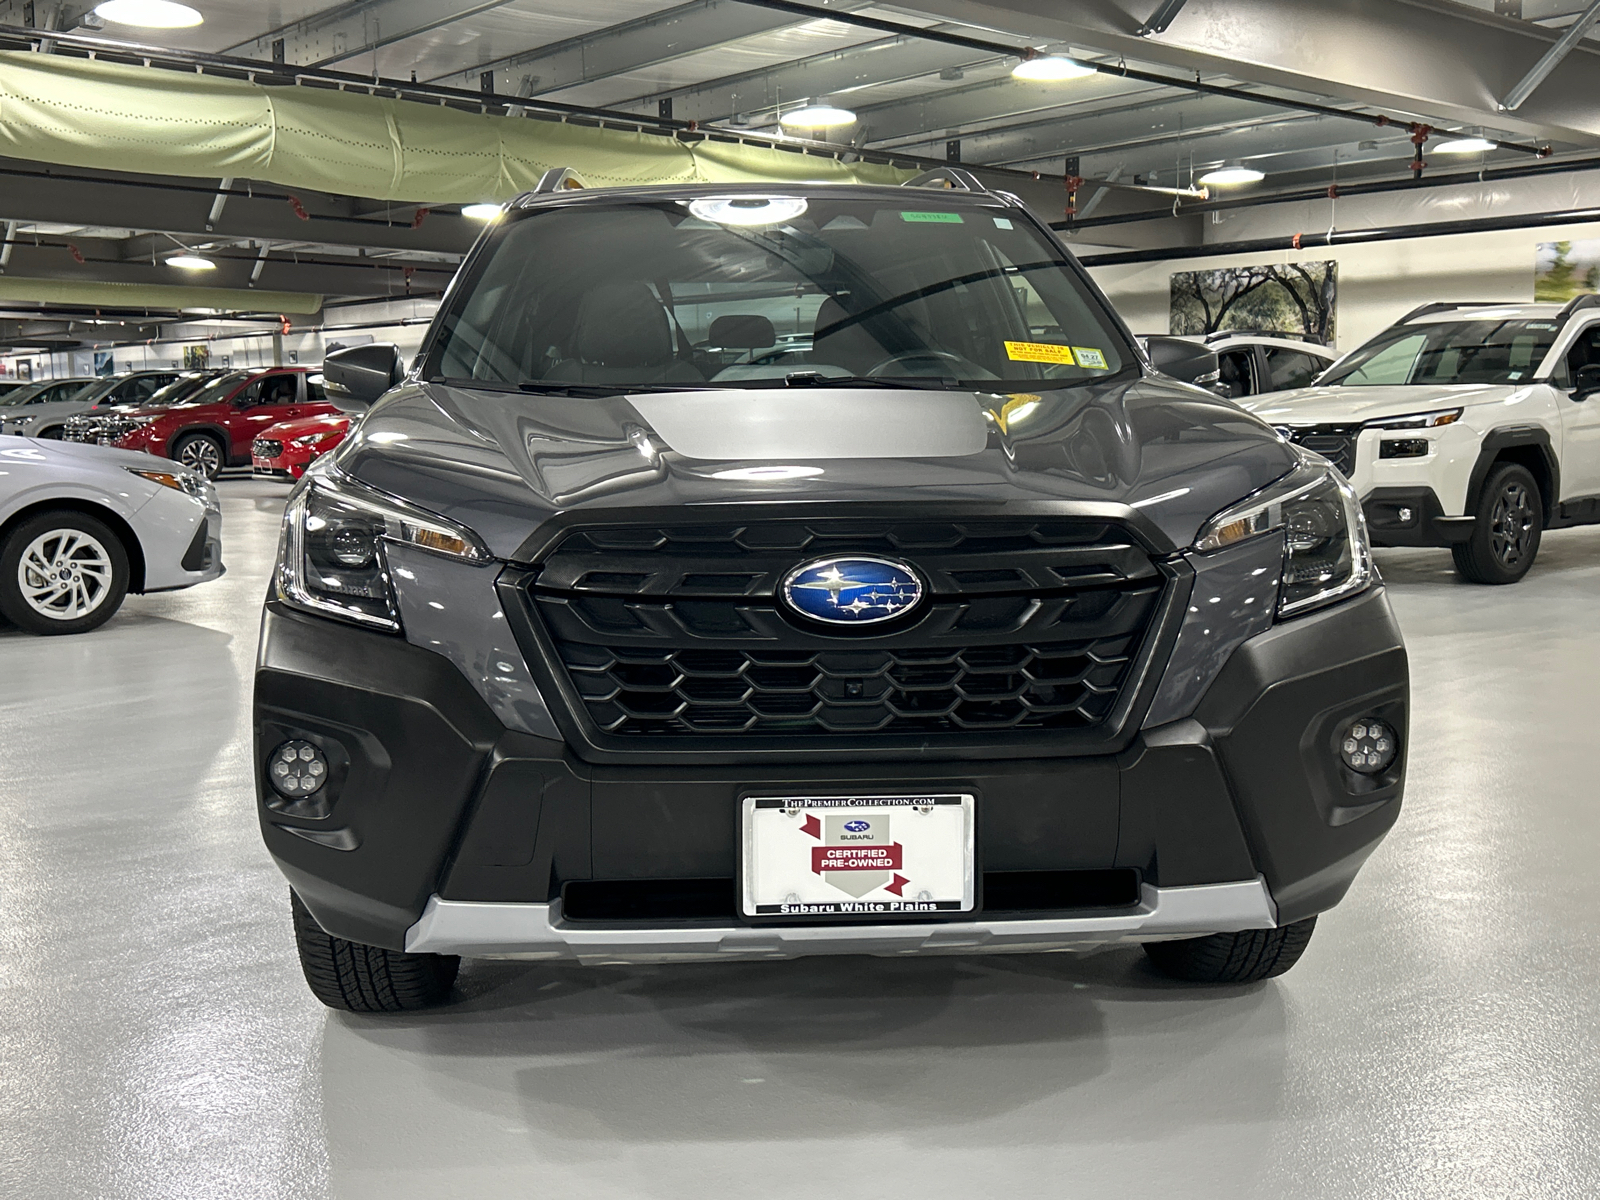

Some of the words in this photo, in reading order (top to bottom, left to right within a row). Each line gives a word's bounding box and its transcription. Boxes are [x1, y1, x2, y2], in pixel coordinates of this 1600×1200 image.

[827, 849, 887, 858] CERTIFIED
[821, 858, 893, 868] PRE-OWNED
[780, 903, 835, 913] Subaru
[840, 902, 885, 912] White
[890, 901, 938, 911] Plains
